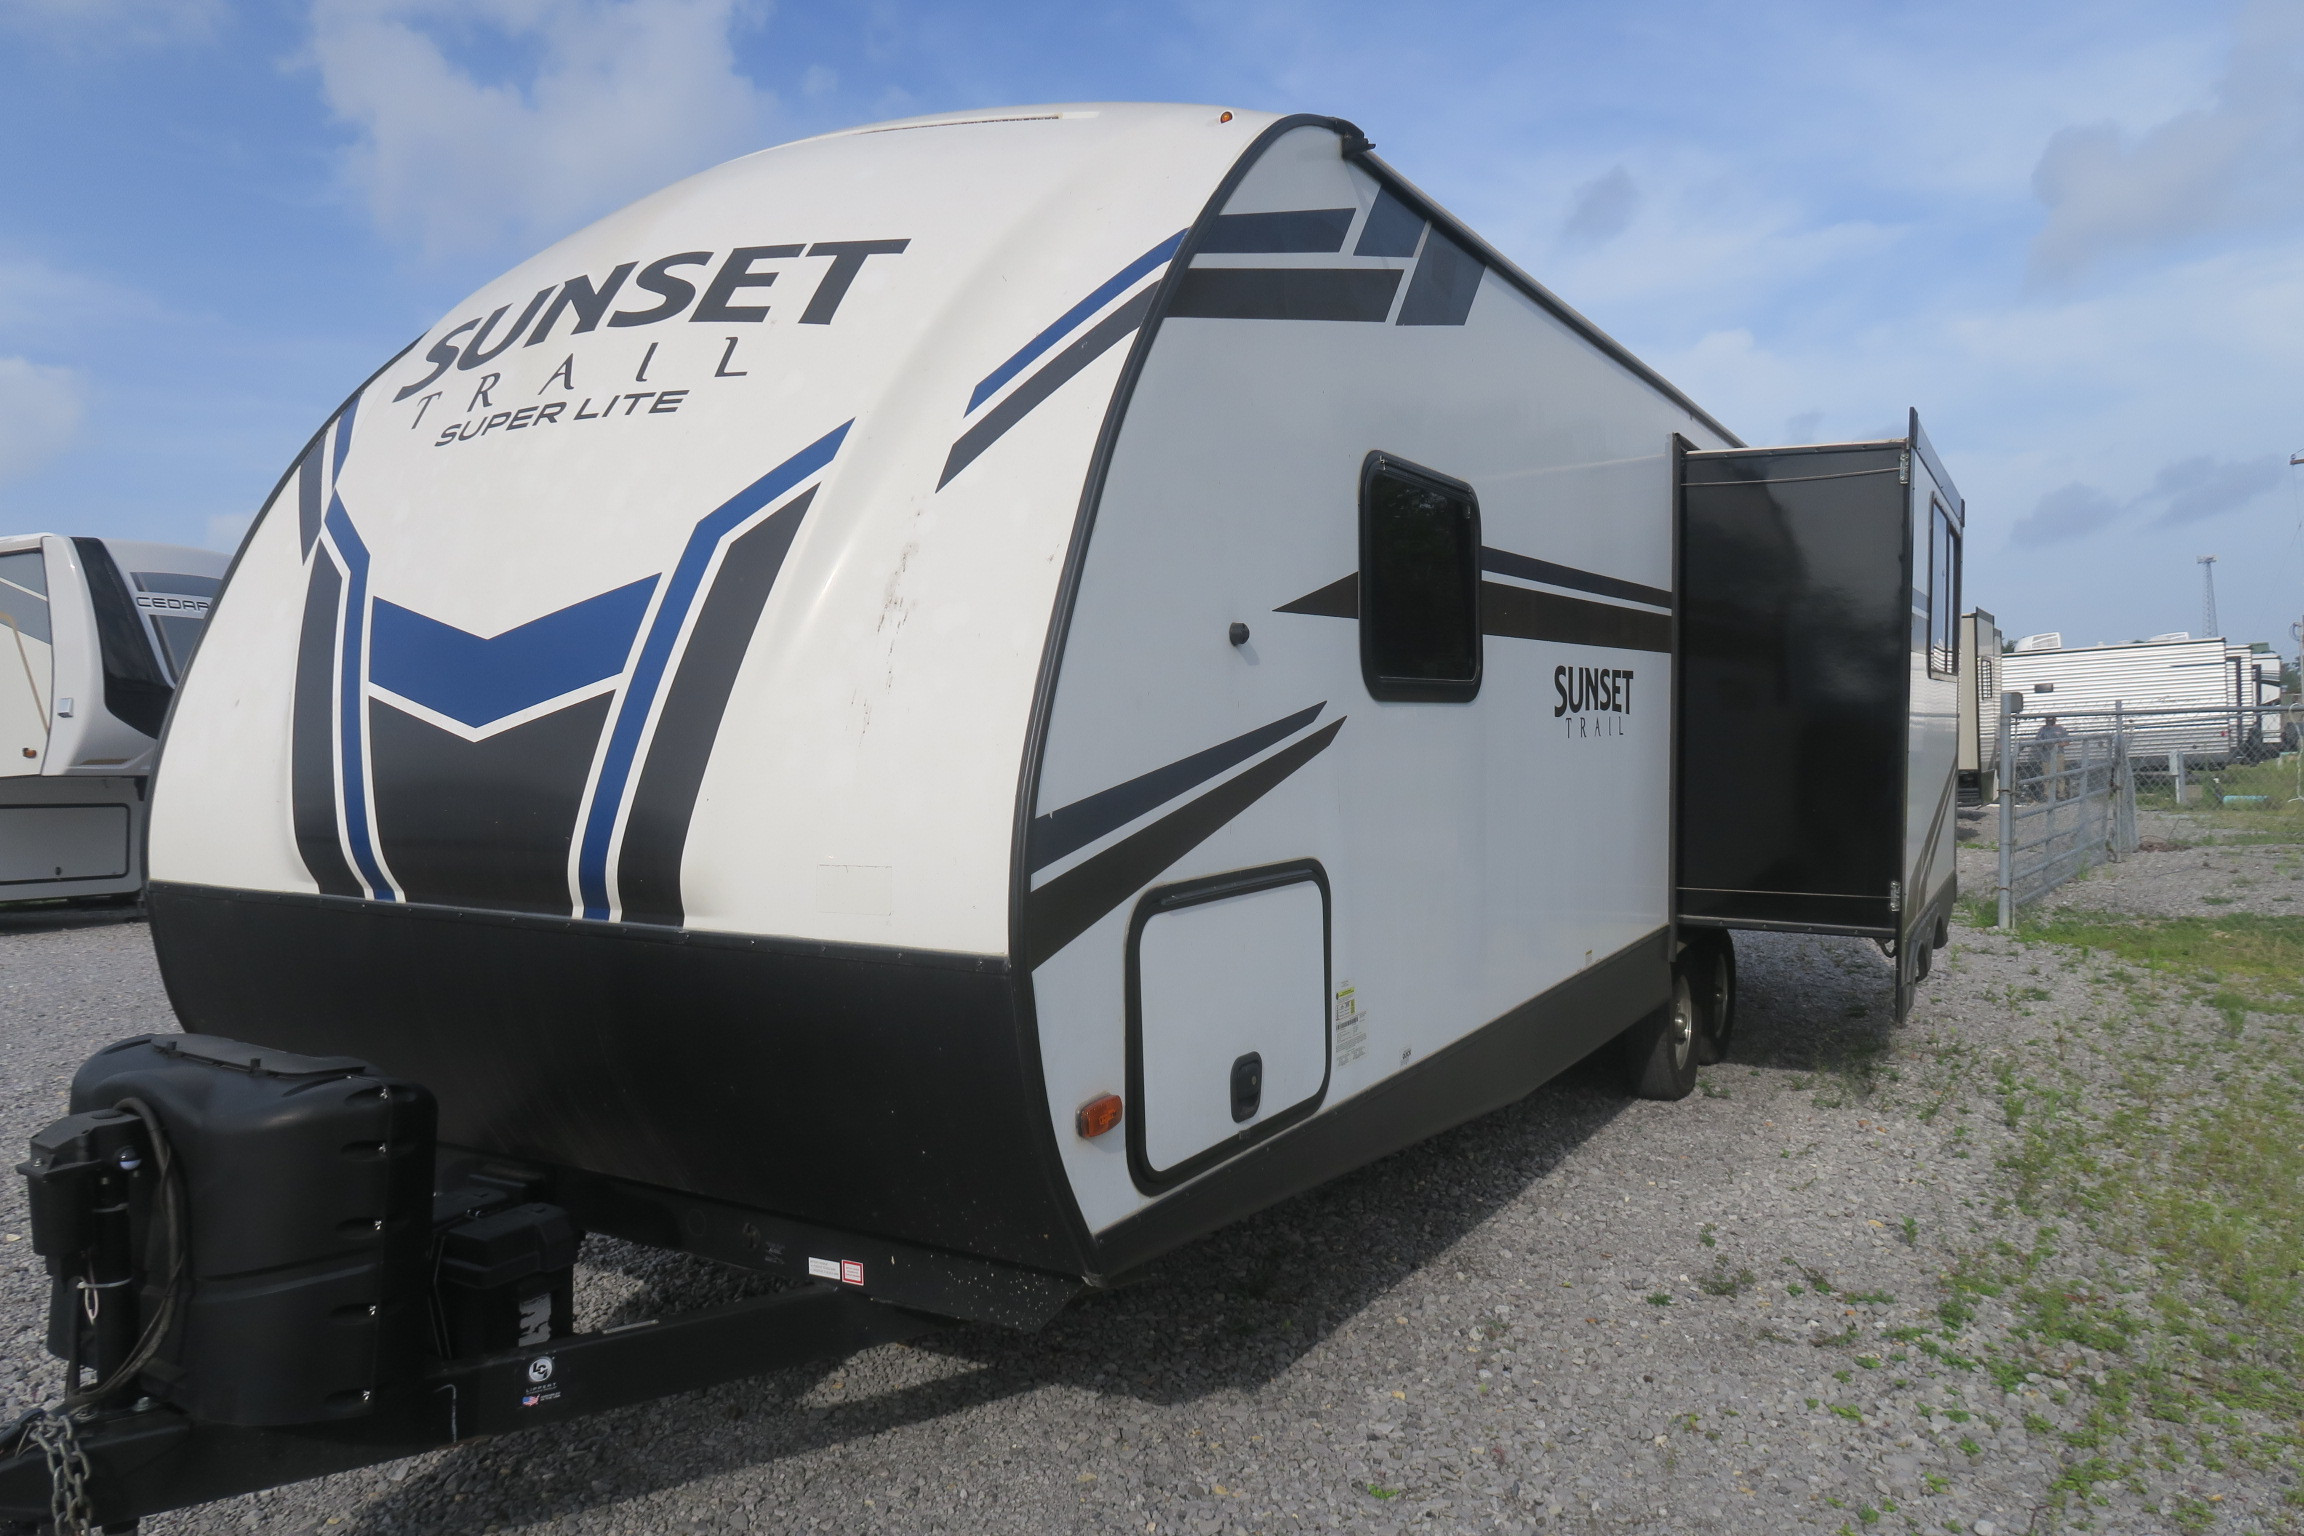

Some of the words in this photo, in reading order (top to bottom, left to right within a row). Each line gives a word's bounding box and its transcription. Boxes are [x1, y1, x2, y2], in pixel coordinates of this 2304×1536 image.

[393, 238, 911, 403] SUNSET
[411, 336, 748, 429] TRAIL
[434, 401, 567, 447] SUPER
[573, 389, 690, 420] LITE
[1554, 665, 1634, 717] SUNSET
[1565, 716, 1624, 739] TRAIL
